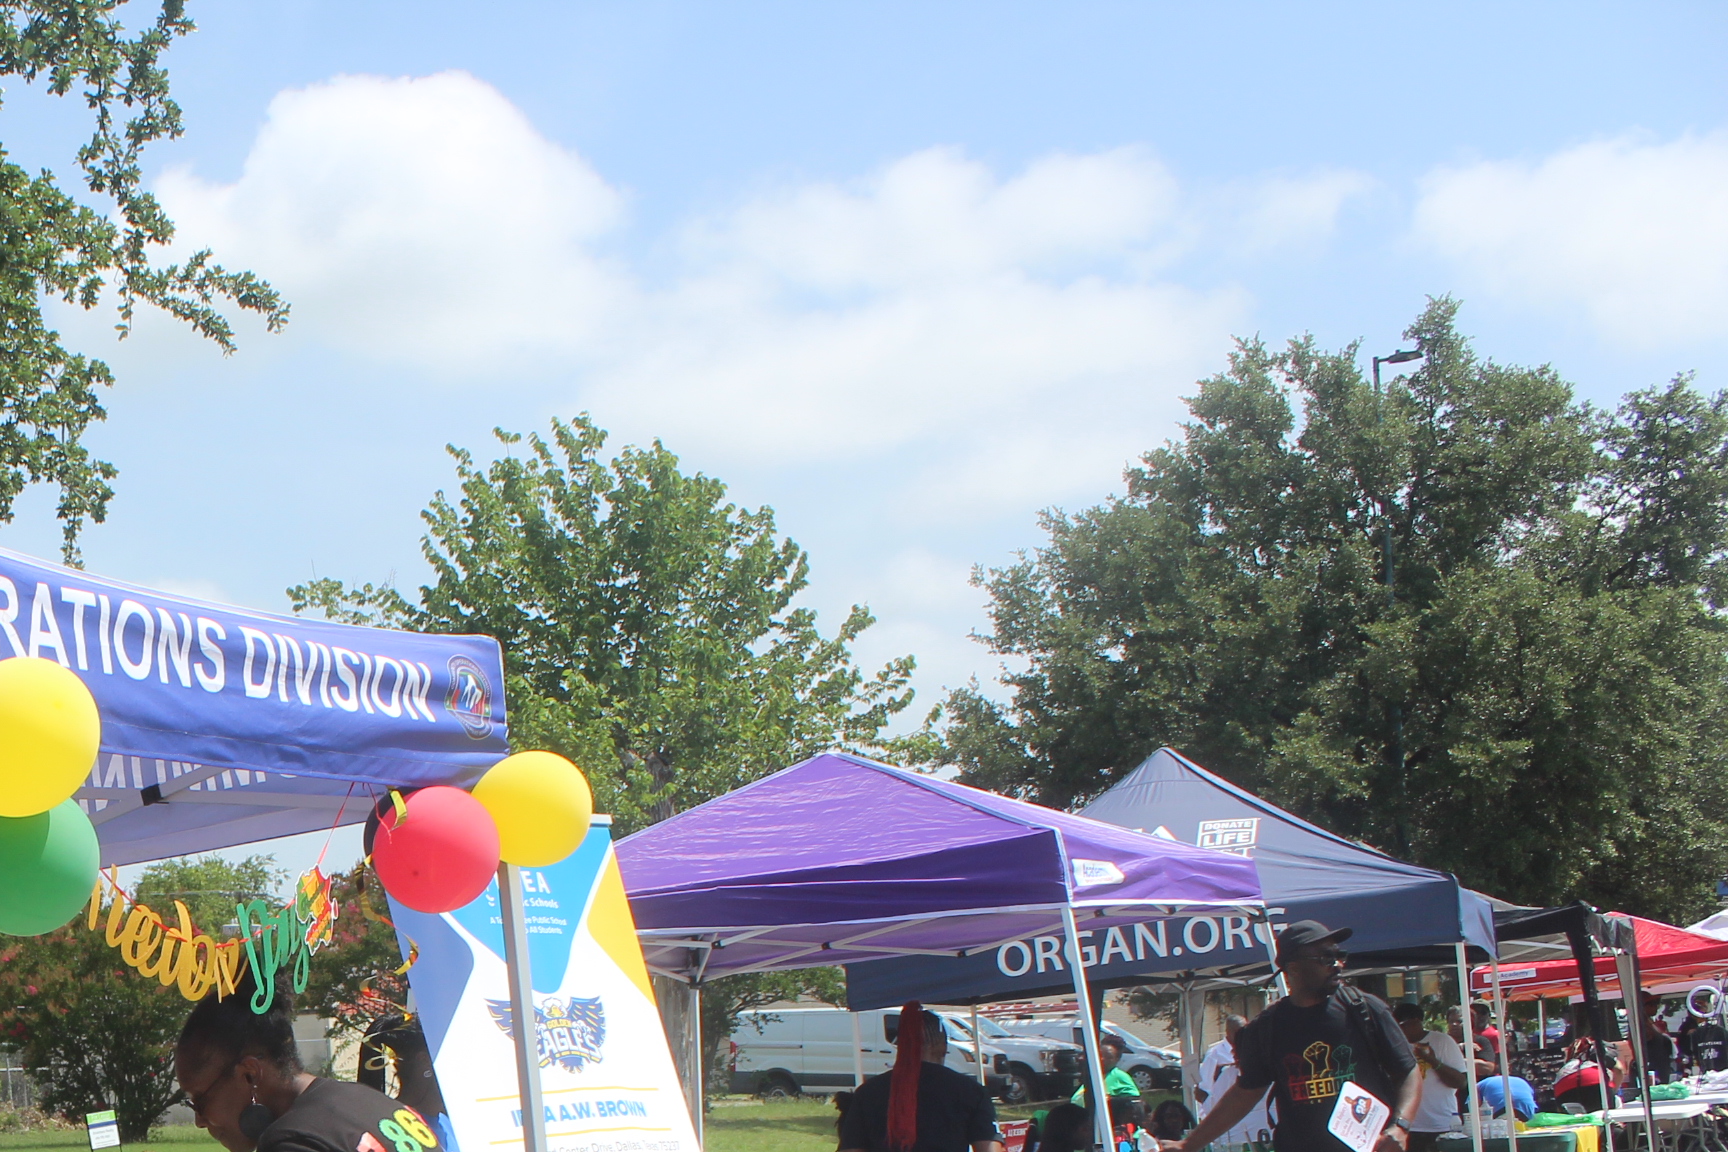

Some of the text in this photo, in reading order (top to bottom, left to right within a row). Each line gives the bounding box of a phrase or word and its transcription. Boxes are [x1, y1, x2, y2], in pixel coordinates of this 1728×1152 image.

[238, 626, 437, 722] DIVISION
[1204, 820, 1252, 831] DONATE
[1201, 832, 1252, 848] LIFE
[518, 870, 551, 894] EA
[1500, 970, 1529, 979] Academy
[511, 1099, 648, 1127] IA A.W. BROWN
[616, 1140, 642, 1152] Dallas,
[642, 1140, 659, 1151] Texas
[658, 1140, 681, 1151] 75237
